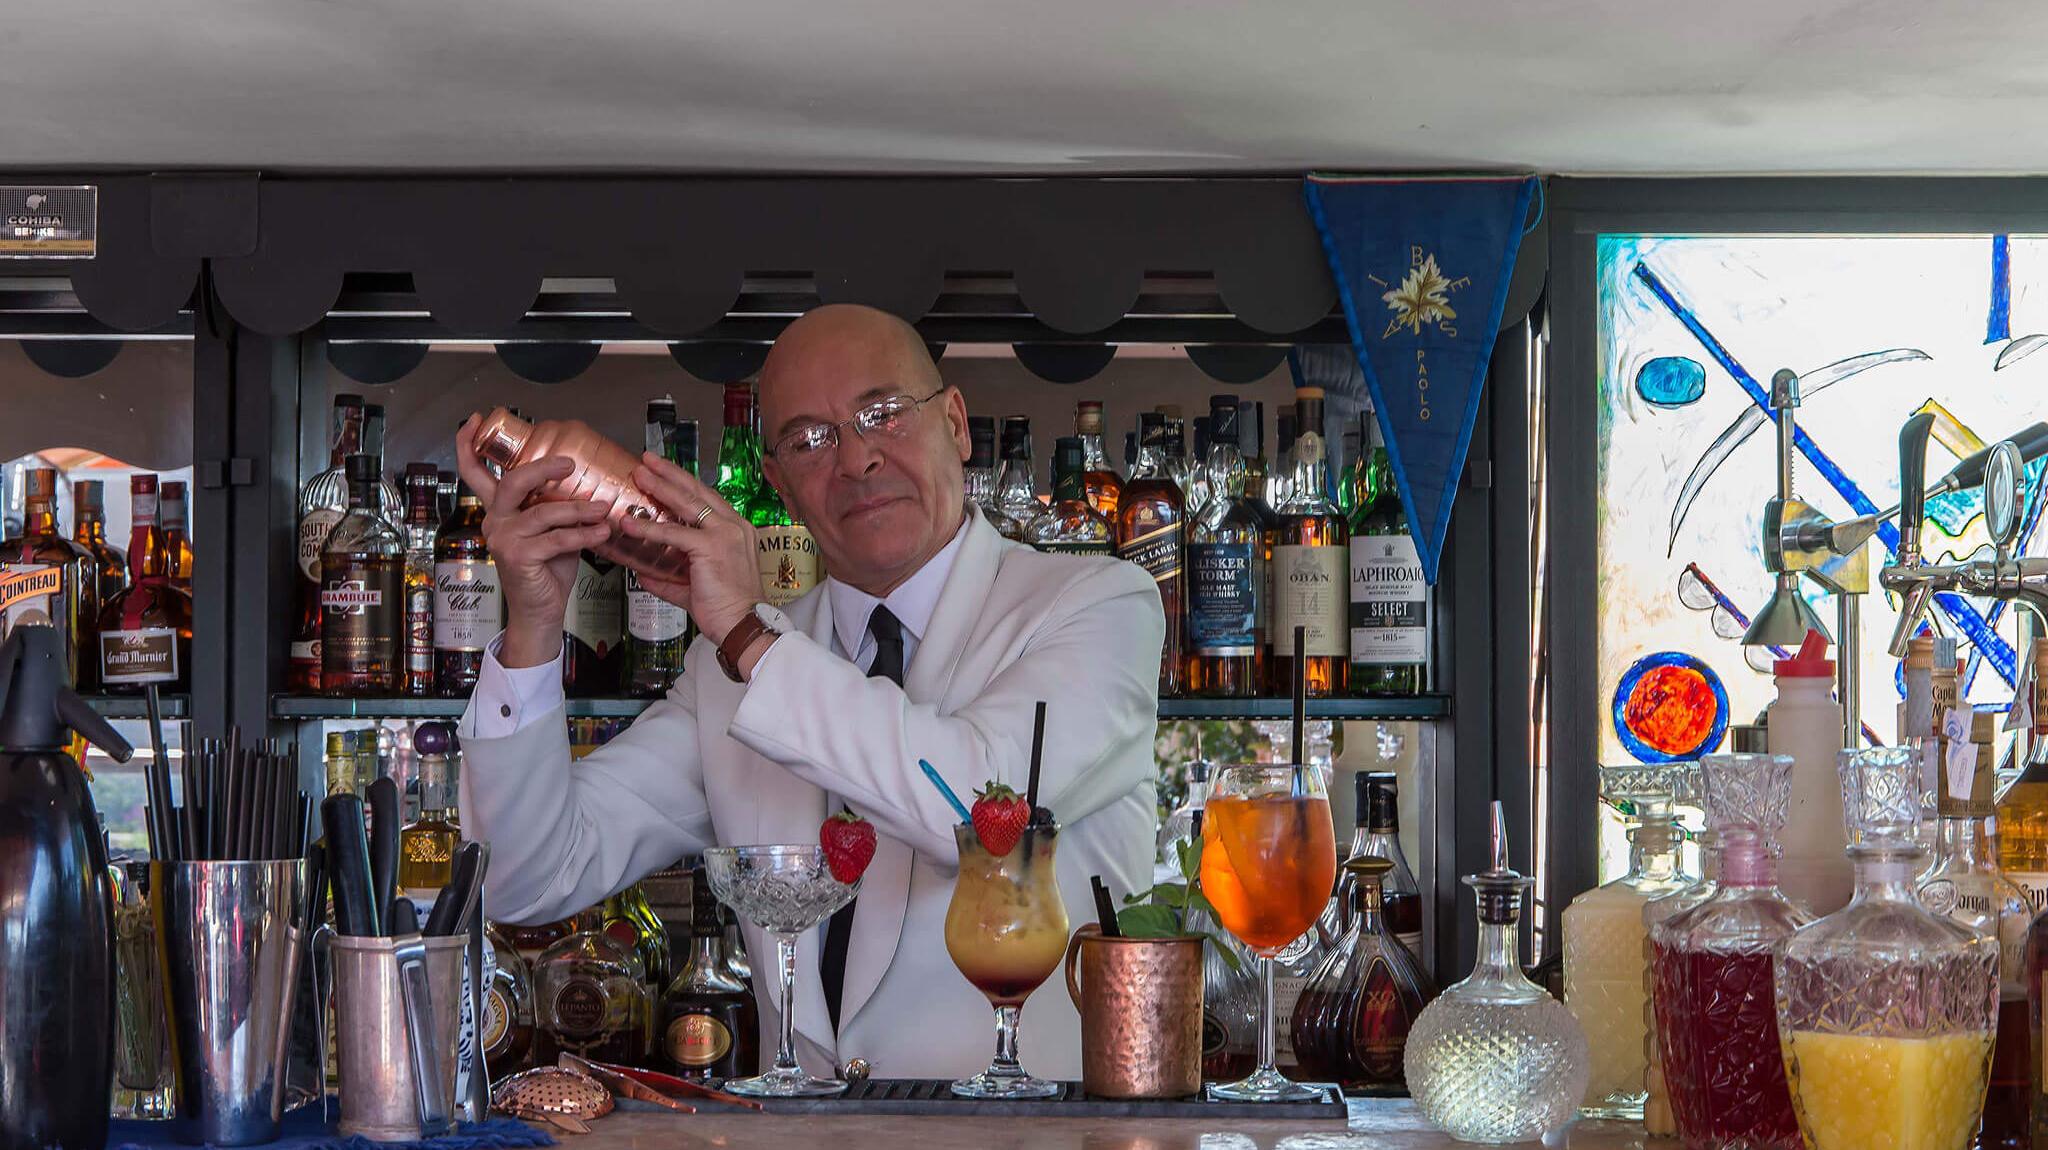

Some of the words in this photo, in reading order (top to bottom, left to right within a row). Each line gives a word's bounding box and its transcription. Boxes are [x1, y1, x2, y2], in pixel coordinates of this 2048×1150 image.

[8, 216, 61, 225] COHIBA
[1417, 350, 1431, 421] PAOLO
[301, 522, 334, 539] SOUTH
[301, 543, 320, 558] COM
[759, 535, 815, 556] AMESON
[1149, 542, 1179, 560] LABEL
[1197, 558, 1245, 569] LISKER
[438, 574, 496, 593] Canadian
[1200, 570, 1236, 581] TORM
[1290, 574, 1329, 583] OBAN
[0, 573, 57, 605] COINTREAU
[323, 592, 378, 603] DRAMBUIE
[448, 592, 482, 611] Club
[1299, 591, 1320, 615] 14
[1371, 601, 1409, 617] SELECT
[107, 650, 129, 665] Grand
[130, 649, 168, 663] Marnier
[1956, 895, 1990, 913] organ
